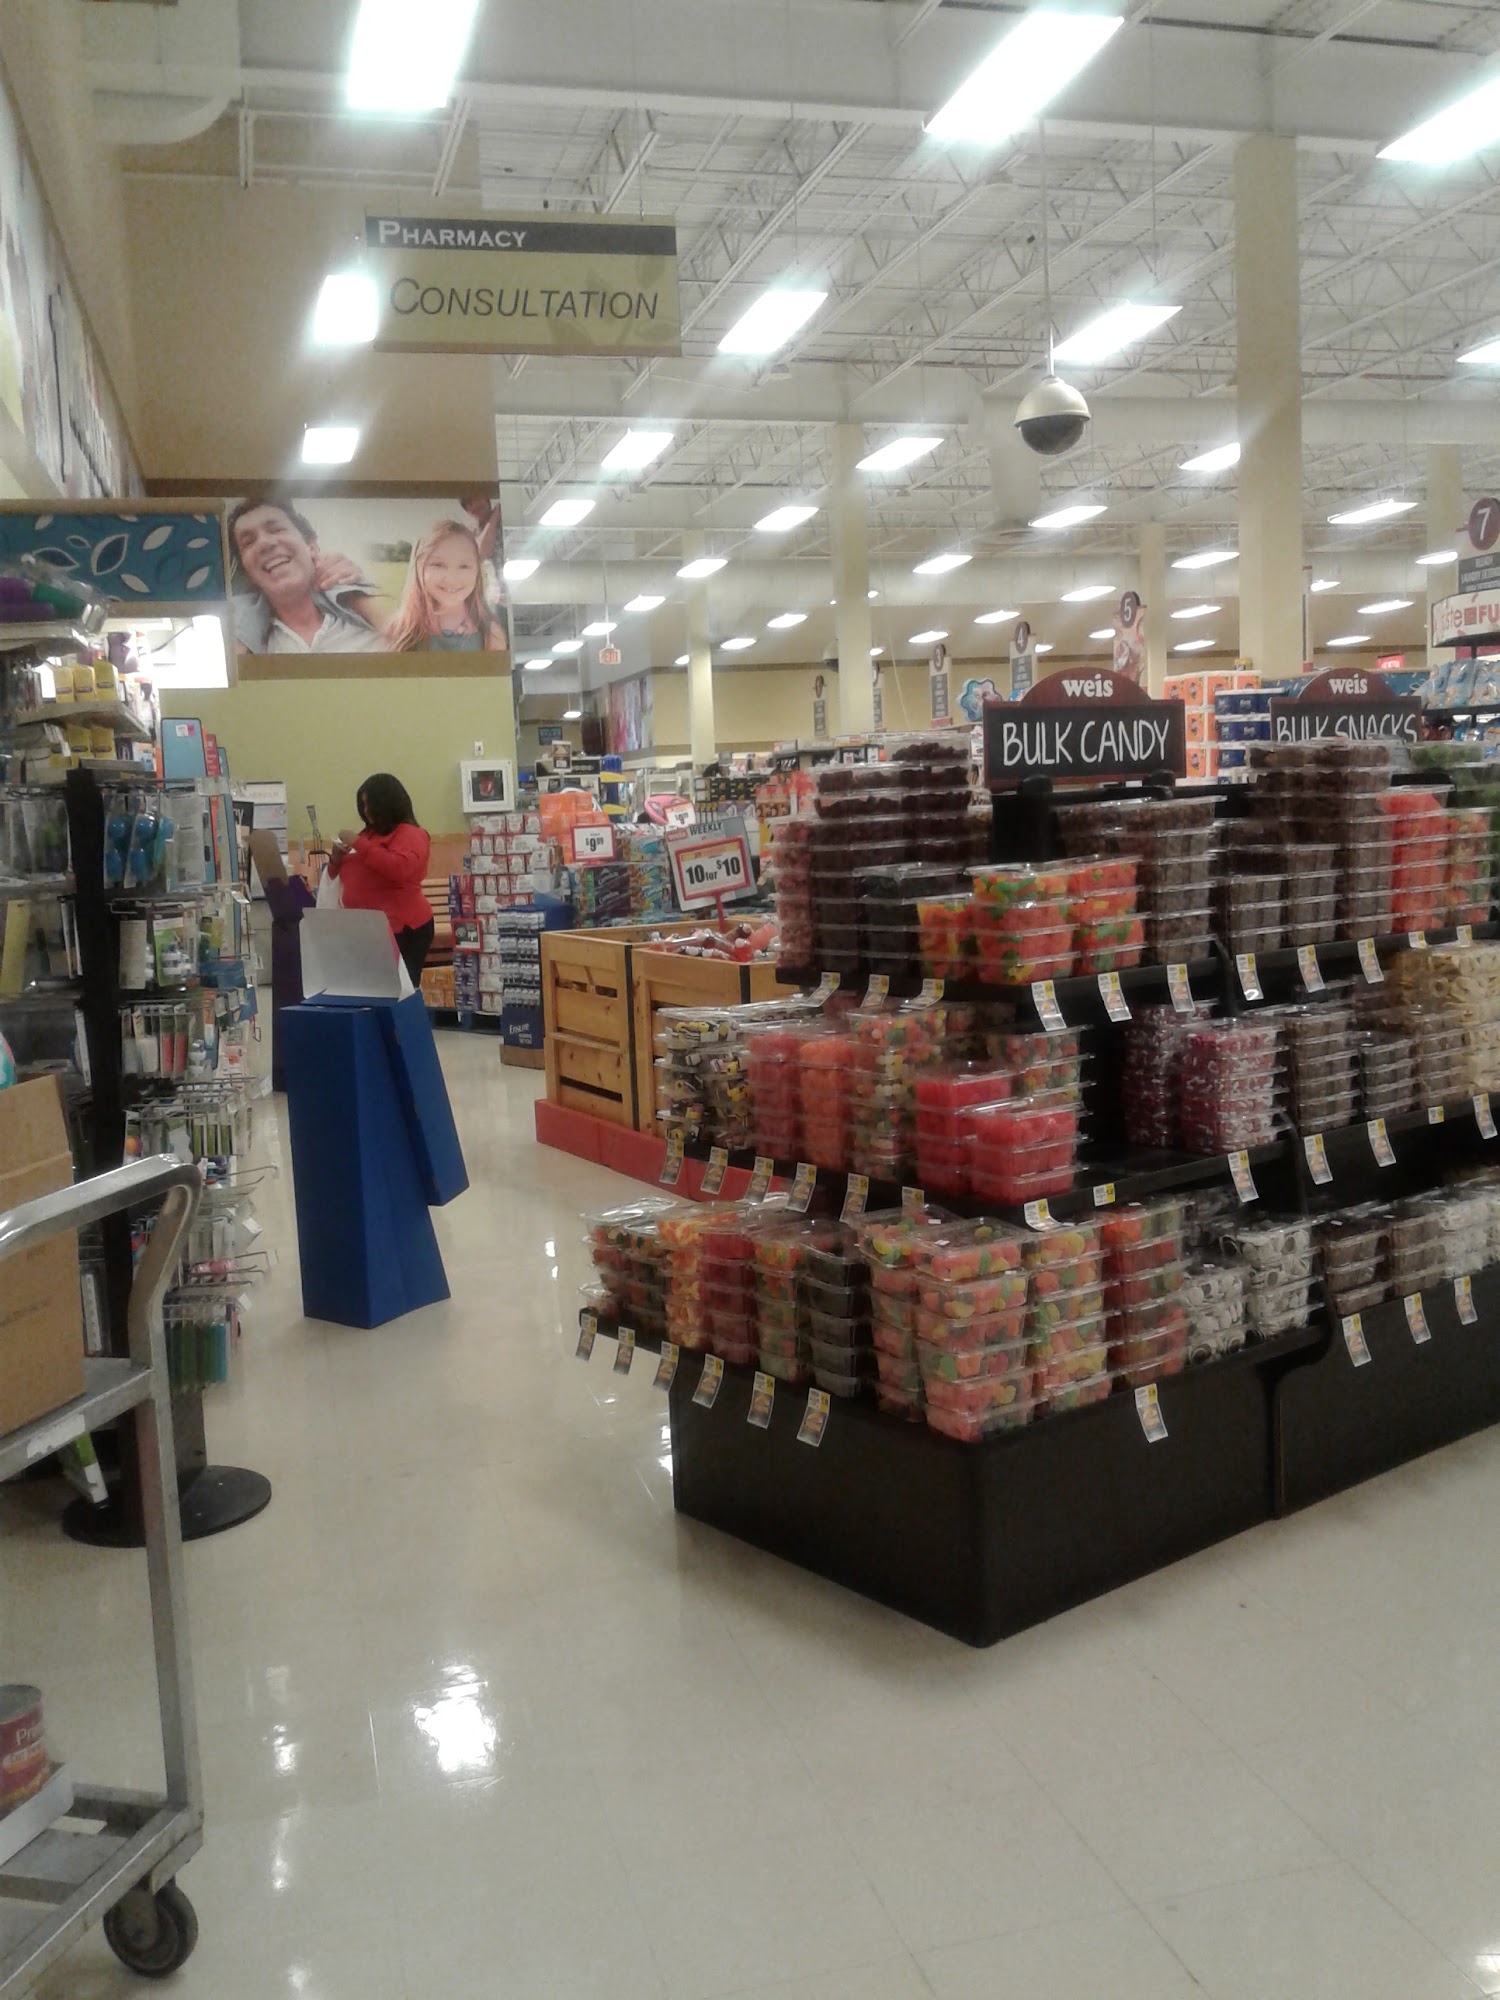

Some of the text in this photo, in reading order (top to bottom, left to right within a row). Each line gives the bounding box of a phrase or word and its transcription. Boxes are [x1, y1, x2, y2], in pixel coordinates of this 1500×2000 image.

[378, 219, 527, 248] PHARMACY
[389, 277, 659, 320] CONSULTATION
[1477, 507, 1491, 541] 7
[1123, 599, 1132, 622] 5
[1017, 629, 1025, 647] 4
[935, 647, 942, 665] 3
[1061, 673, 1114, 698] weis
[1328, 673, 1368, 695] weis
[1334, 713, 1418, 743] SNACKS
[1003, 718, 1170, 767] BULK CANDY
[689, 821, 724, 836] WEEKLY
[685, 864, 706, 885] 10
[705, 870, 718, 881] for
[715, 856, 741, 877] $10
